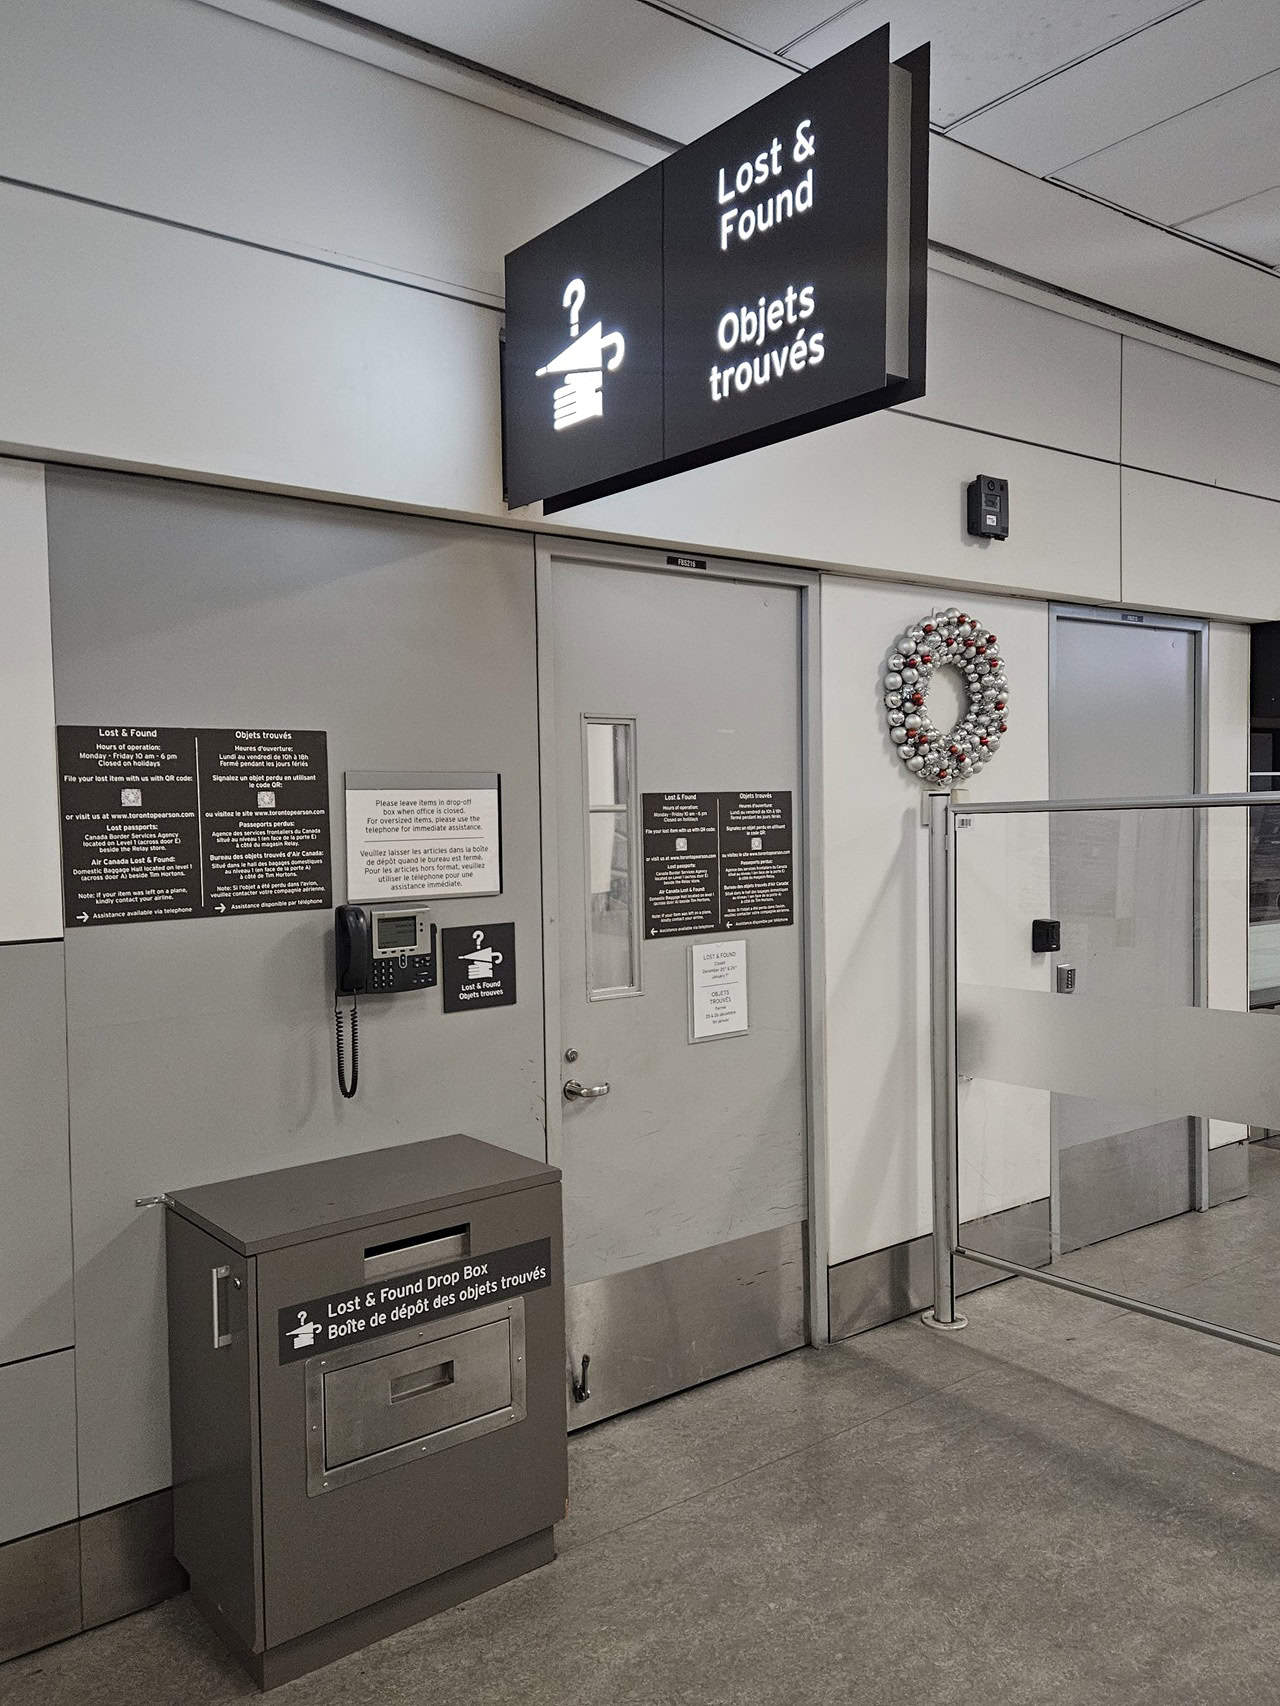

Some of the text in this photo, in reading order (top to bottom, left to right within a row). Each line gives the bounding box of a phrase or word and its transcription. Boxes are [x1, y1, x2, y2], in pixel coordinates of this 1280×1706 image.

[718, 119, 815, 204] Lost &
[720, 168, 814, 250] Found
[717, 285, 815, 351] Objets
[709, 328, 825, 402] trouvés
[236, 731, 292, 740] Objets trouvés
[365, 826, 400, 834] telephone
[376, 858, 396, 866] dépôt
[378, 875, 402, 883] utiliser
[412, 873, 444, 881] téléphone
[459, 992, 480, 1000] Objets
[328, 1263, 488, 1317] Lost & Found Drop Box
[328, 1265, 547, 1340] Boîte de dépôt des objets trouvés
